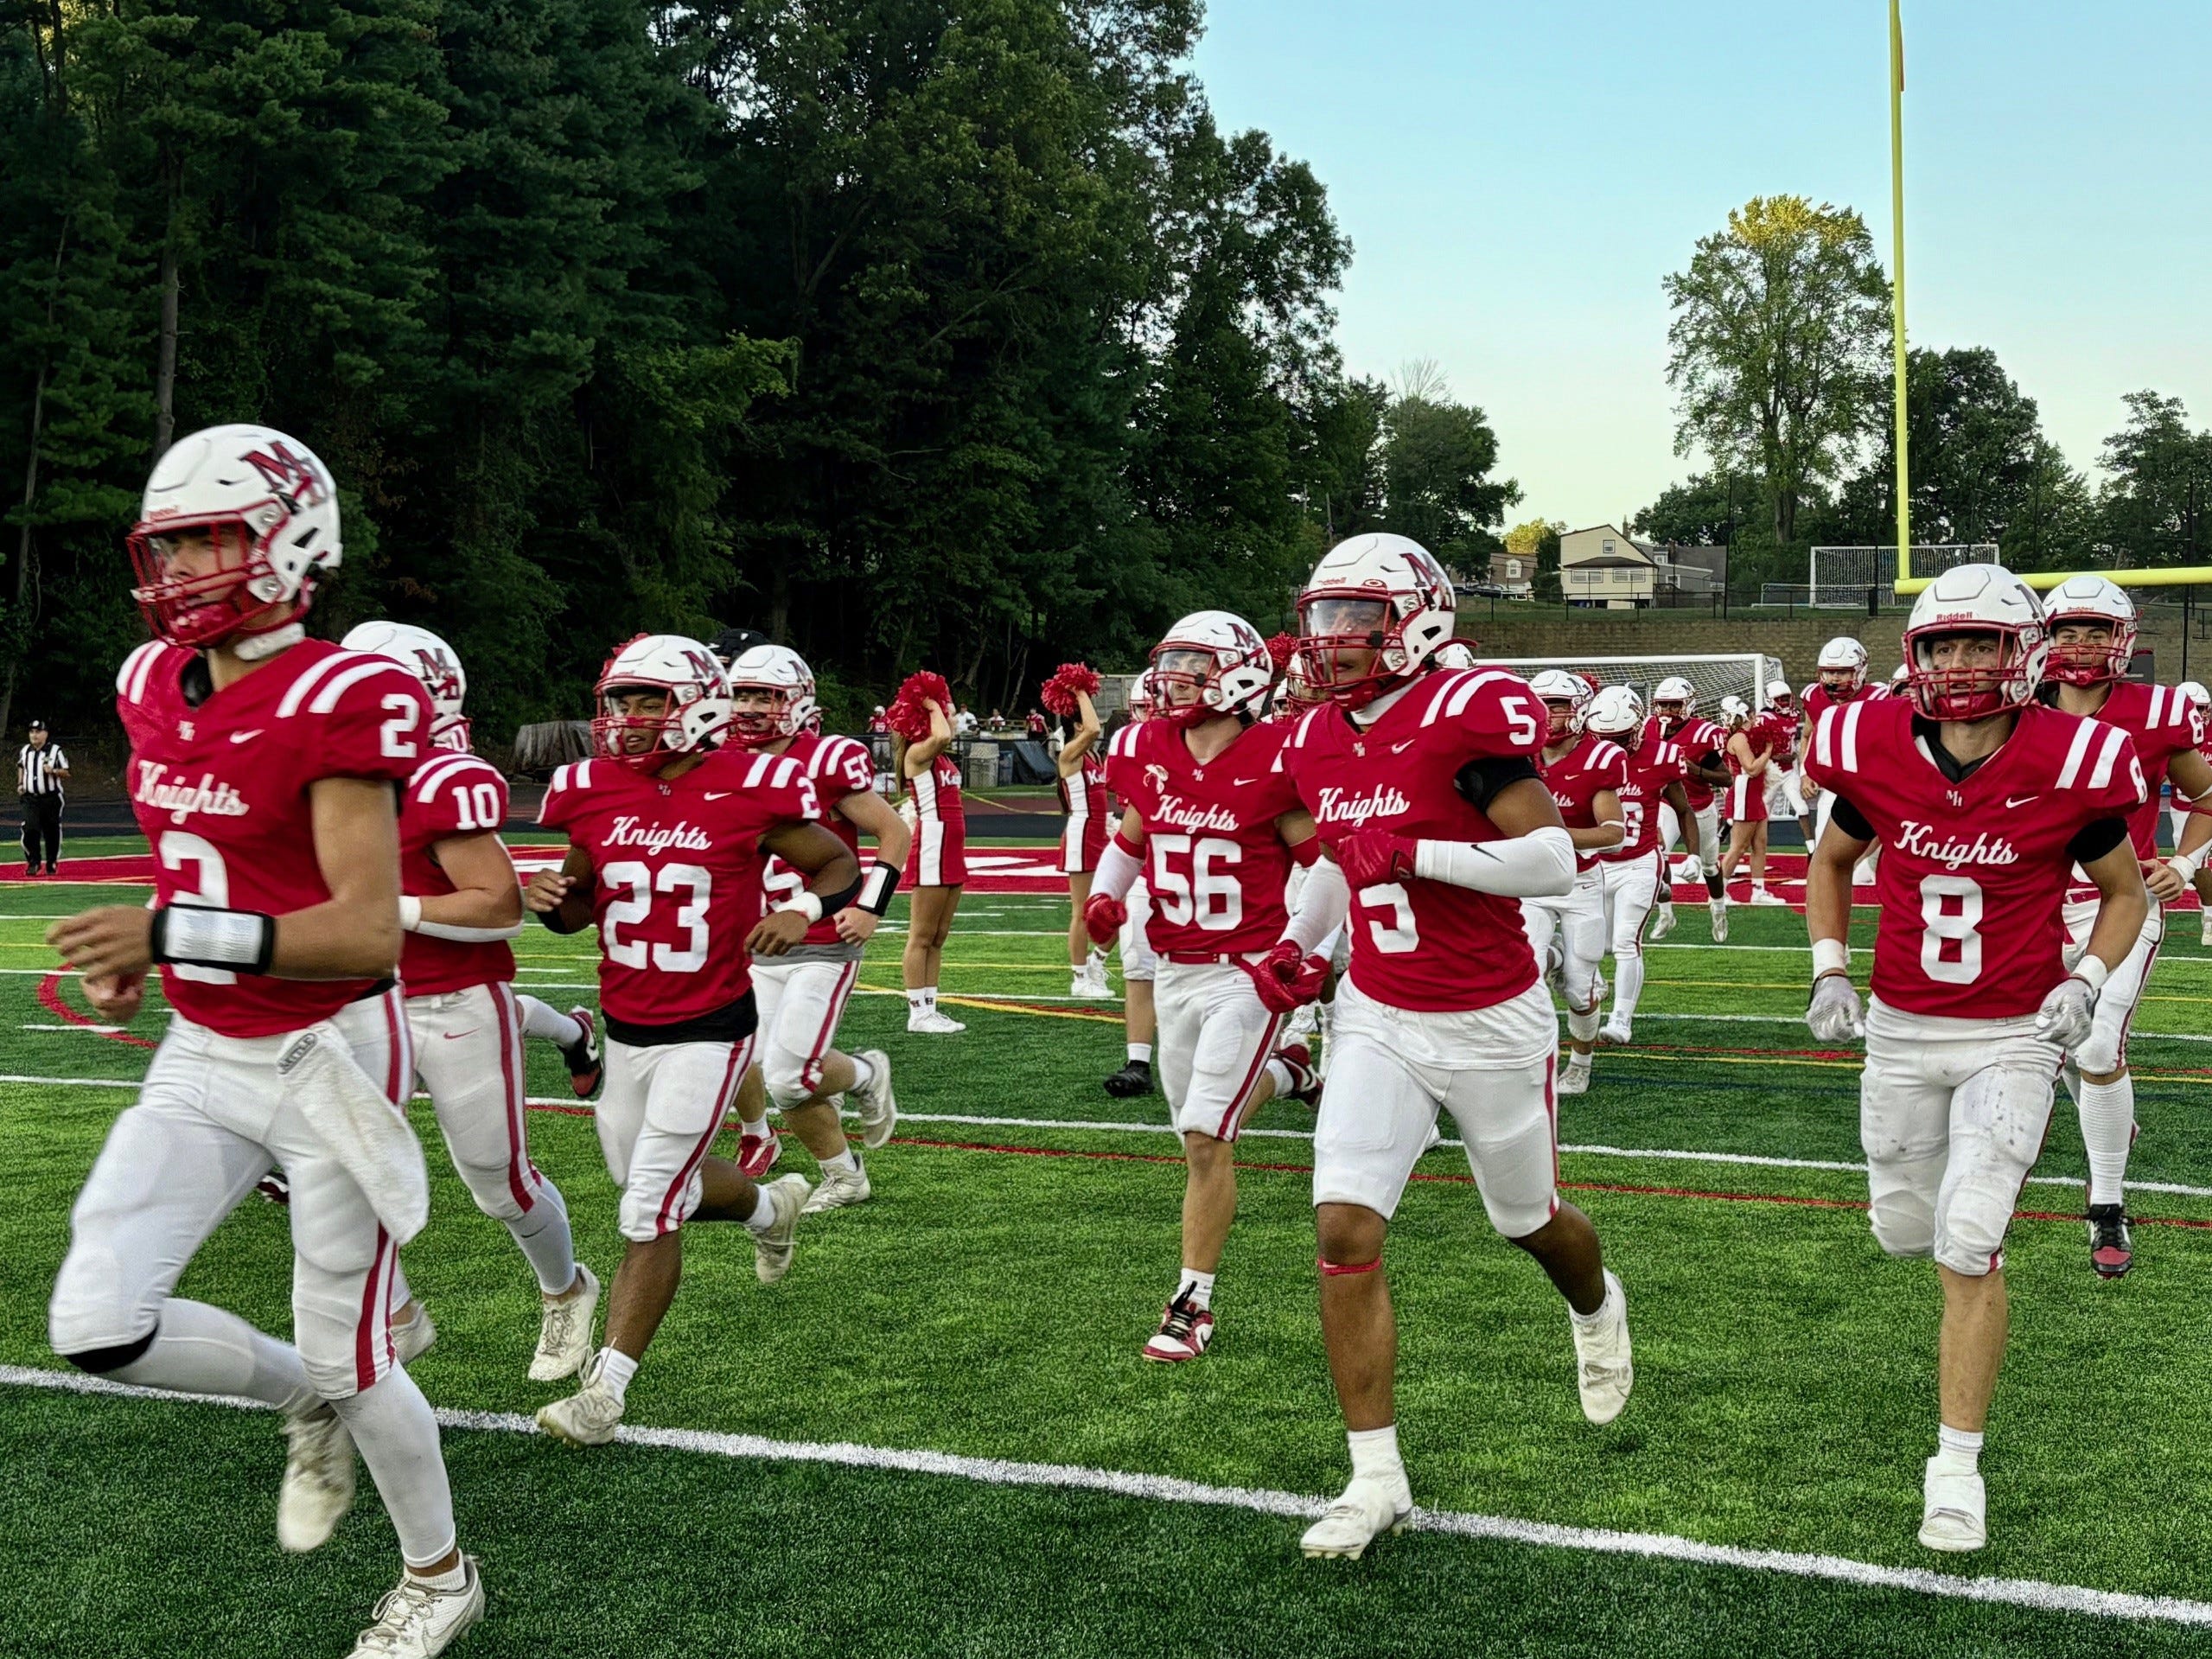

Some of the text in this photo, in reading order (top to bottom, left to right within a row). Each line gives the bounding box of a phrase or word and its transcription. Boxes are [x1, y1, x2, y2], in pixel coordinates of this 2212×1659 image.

[380, 693, 420, 758] 2
[1499, 696, 1536, 746] 5
[135, 759, 250, 825] Knights
[451, 782, 500, 831] 10
[1149, 794, 1240, 835] Knights
[1315, 783, 1411, 827] Knights
[1946, 789, 1963, 807] MH
[601, 815, 713, 857] Knights
[1893, 820, 2019, 871] Knights
[760, 853, 805, 917] 5
[1150, 833, 1243, 931] 56
[602, 860, 712, 973] 23
[1359, 882, 1420, 954] 5
[1919, 874, 1983, 986] 8
